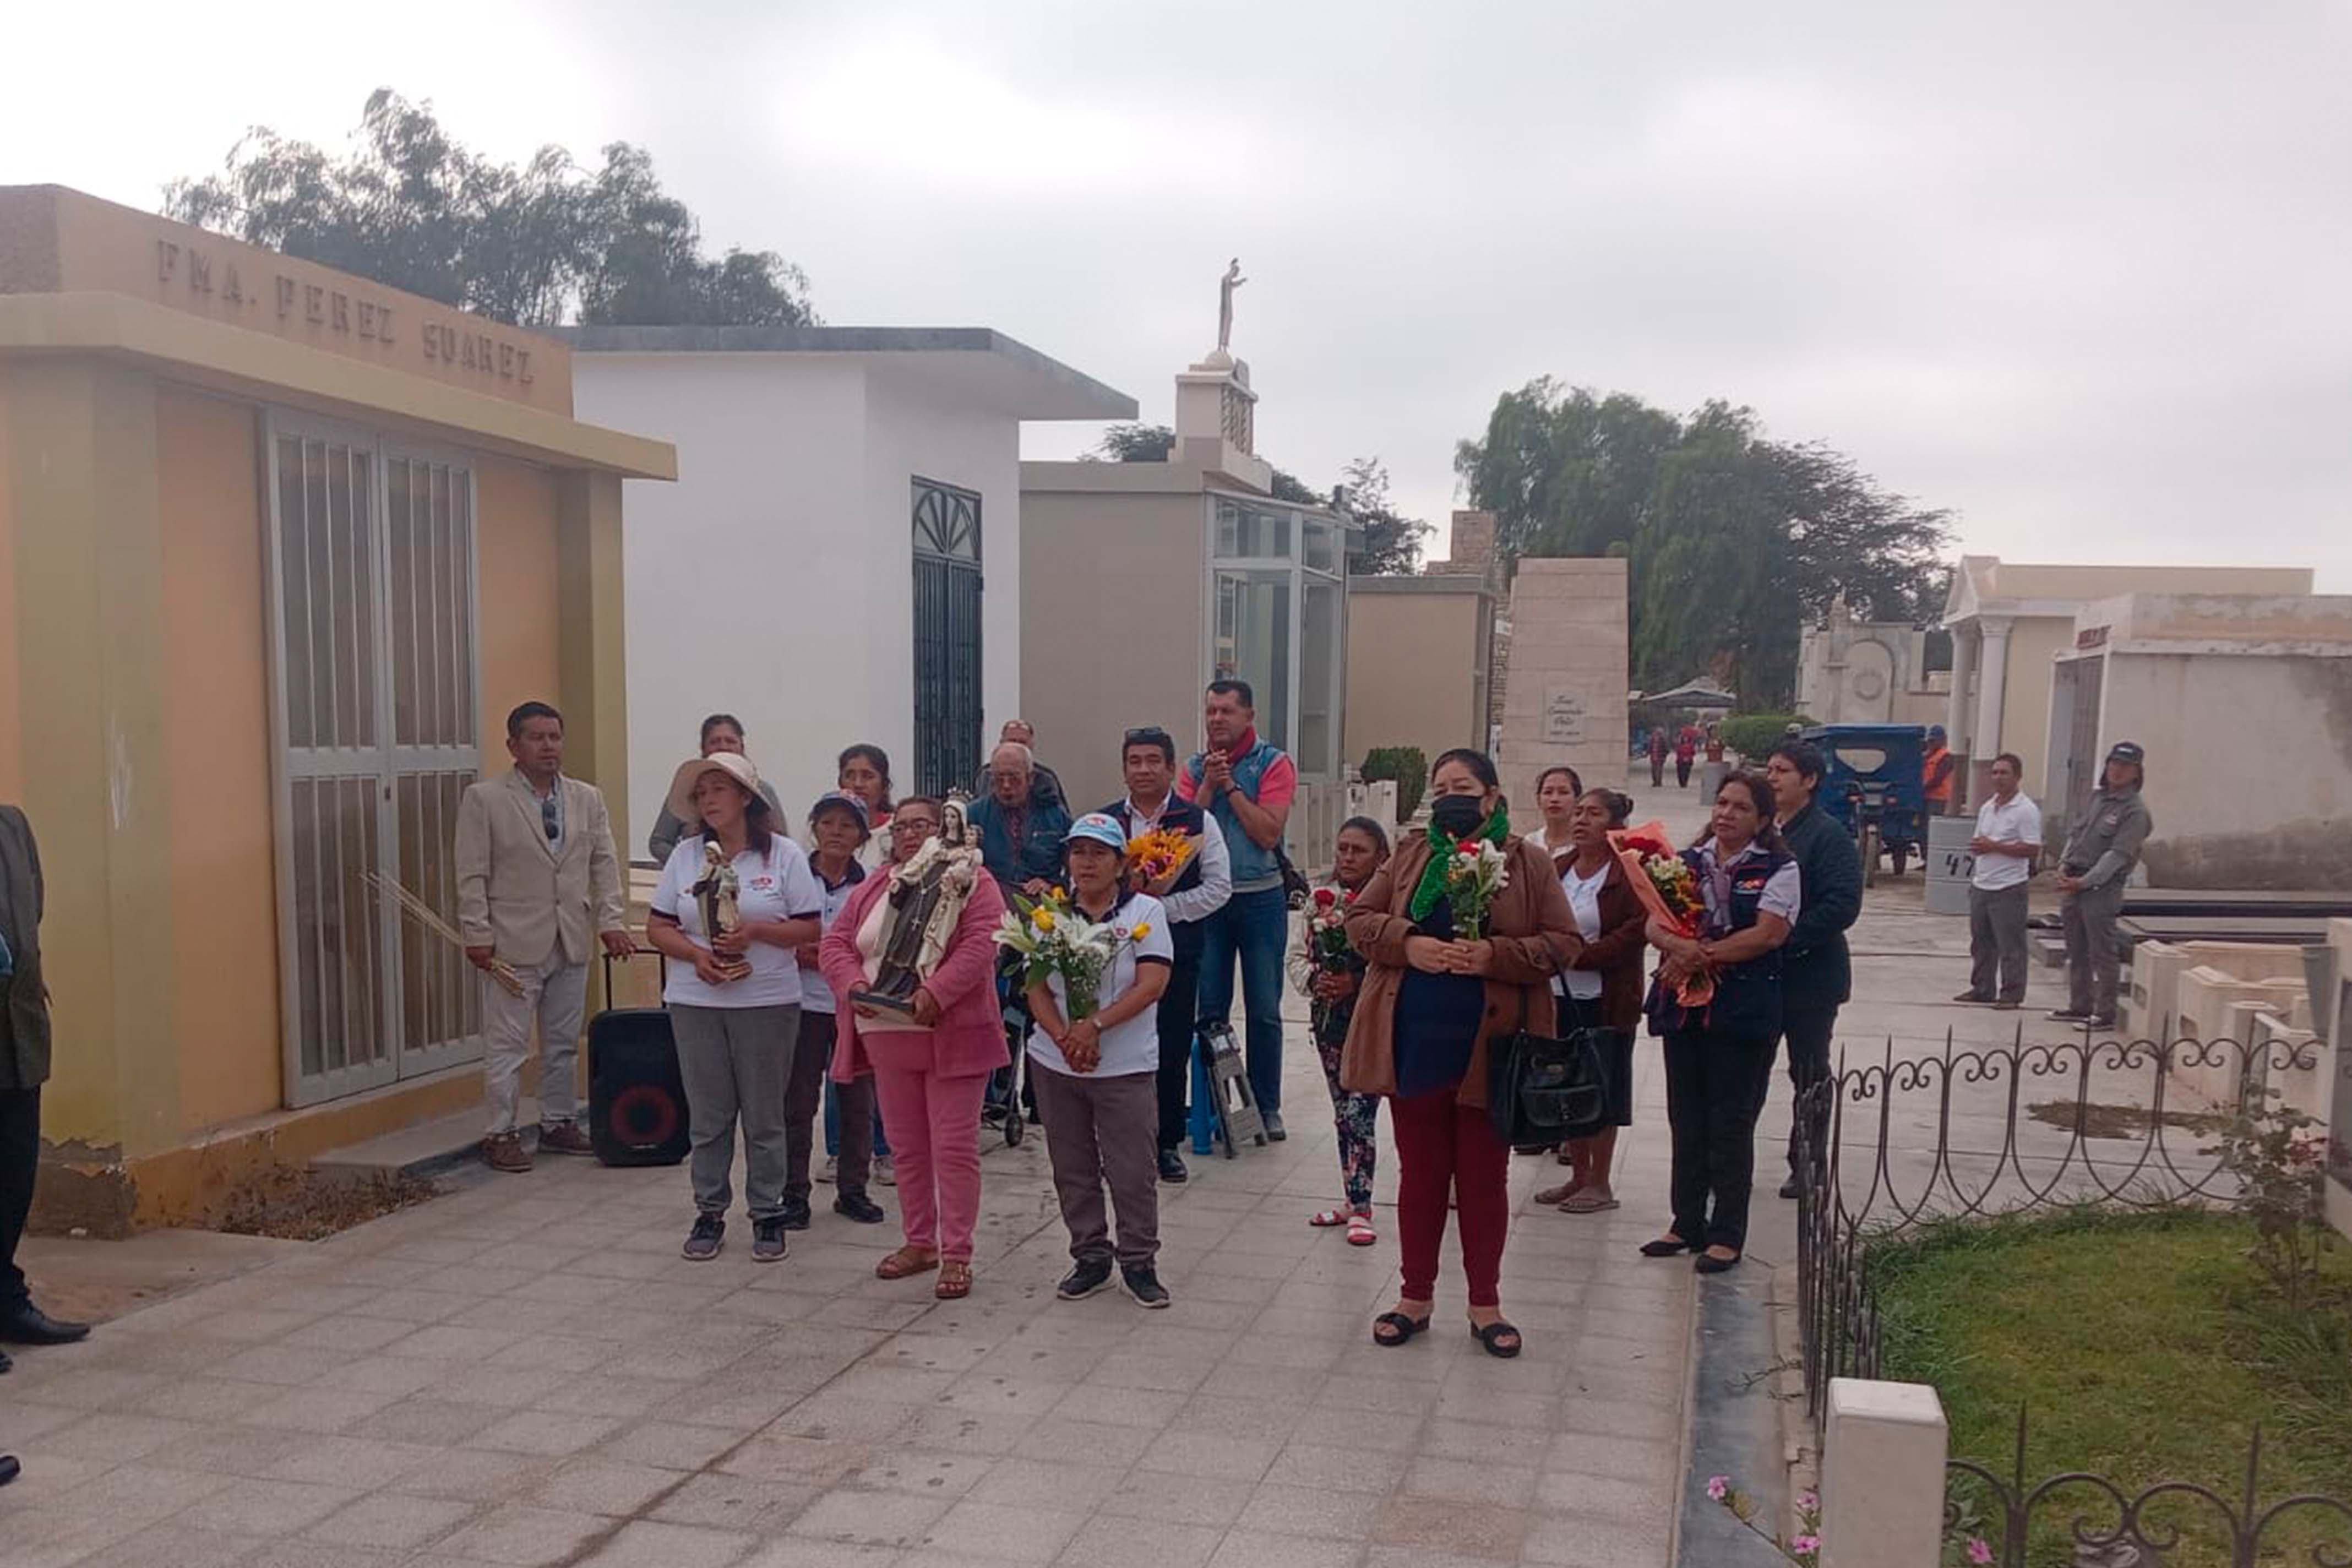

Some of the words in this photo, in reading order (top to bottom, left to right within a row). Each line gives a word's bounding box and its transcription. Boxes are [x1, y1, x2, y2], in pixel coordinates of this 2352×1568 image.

[275, 274, 395, 344] PEREZ
[422, 324, 535, 384] SUAREZ
[1946, 854, 1975, 876] 47
